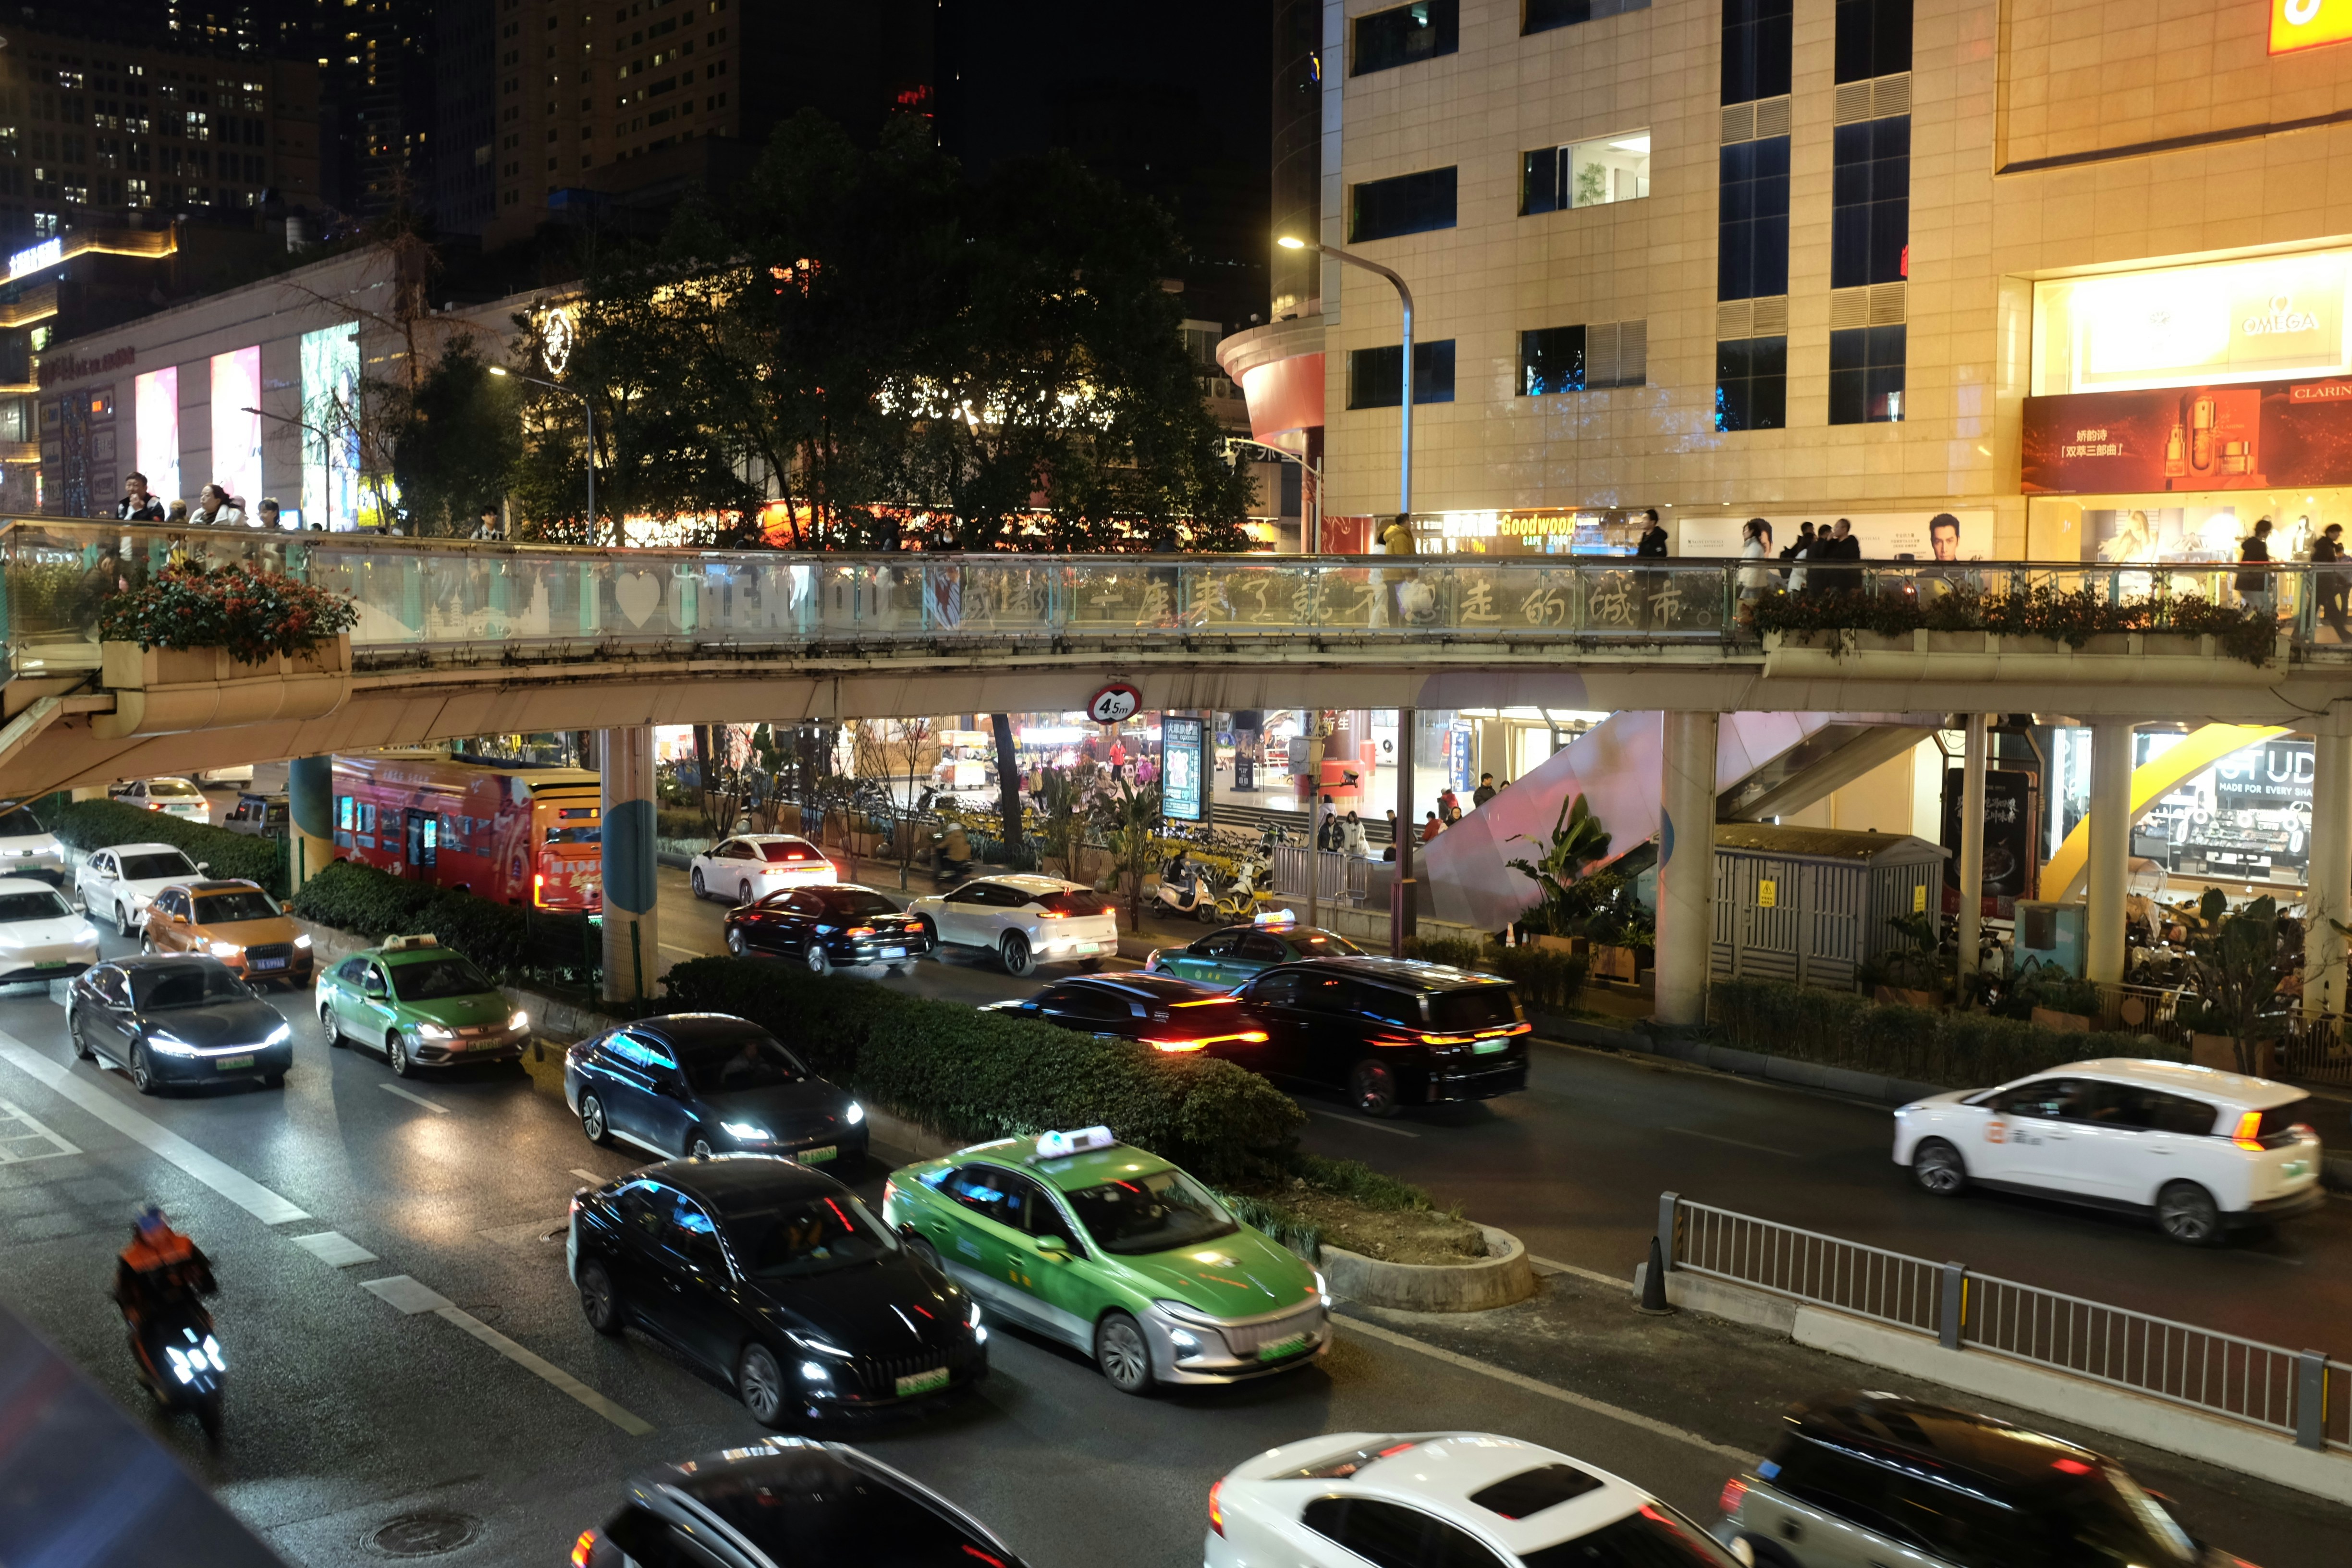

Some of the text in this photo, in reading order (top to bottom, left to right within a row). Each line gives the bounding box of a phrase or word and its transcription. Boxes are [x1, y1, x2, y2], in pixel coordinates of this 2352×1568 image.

[2242, 313, 2315, 333] OMEGA
[2294, 386, 2352, 399] CLARIN
[2076, 429, 2107, 442] 娇韵诗
[1501, 513, 1577, 536] Goodwood
[1522, 535, 1542, 546] CAFE
[1099, 697, 1128, 715] 4.5m
[2219, 782, 2243, 793] MADE
[2245, 784, 2262, 794] FOR
[2266, 786, 2292, 796] EVERY
